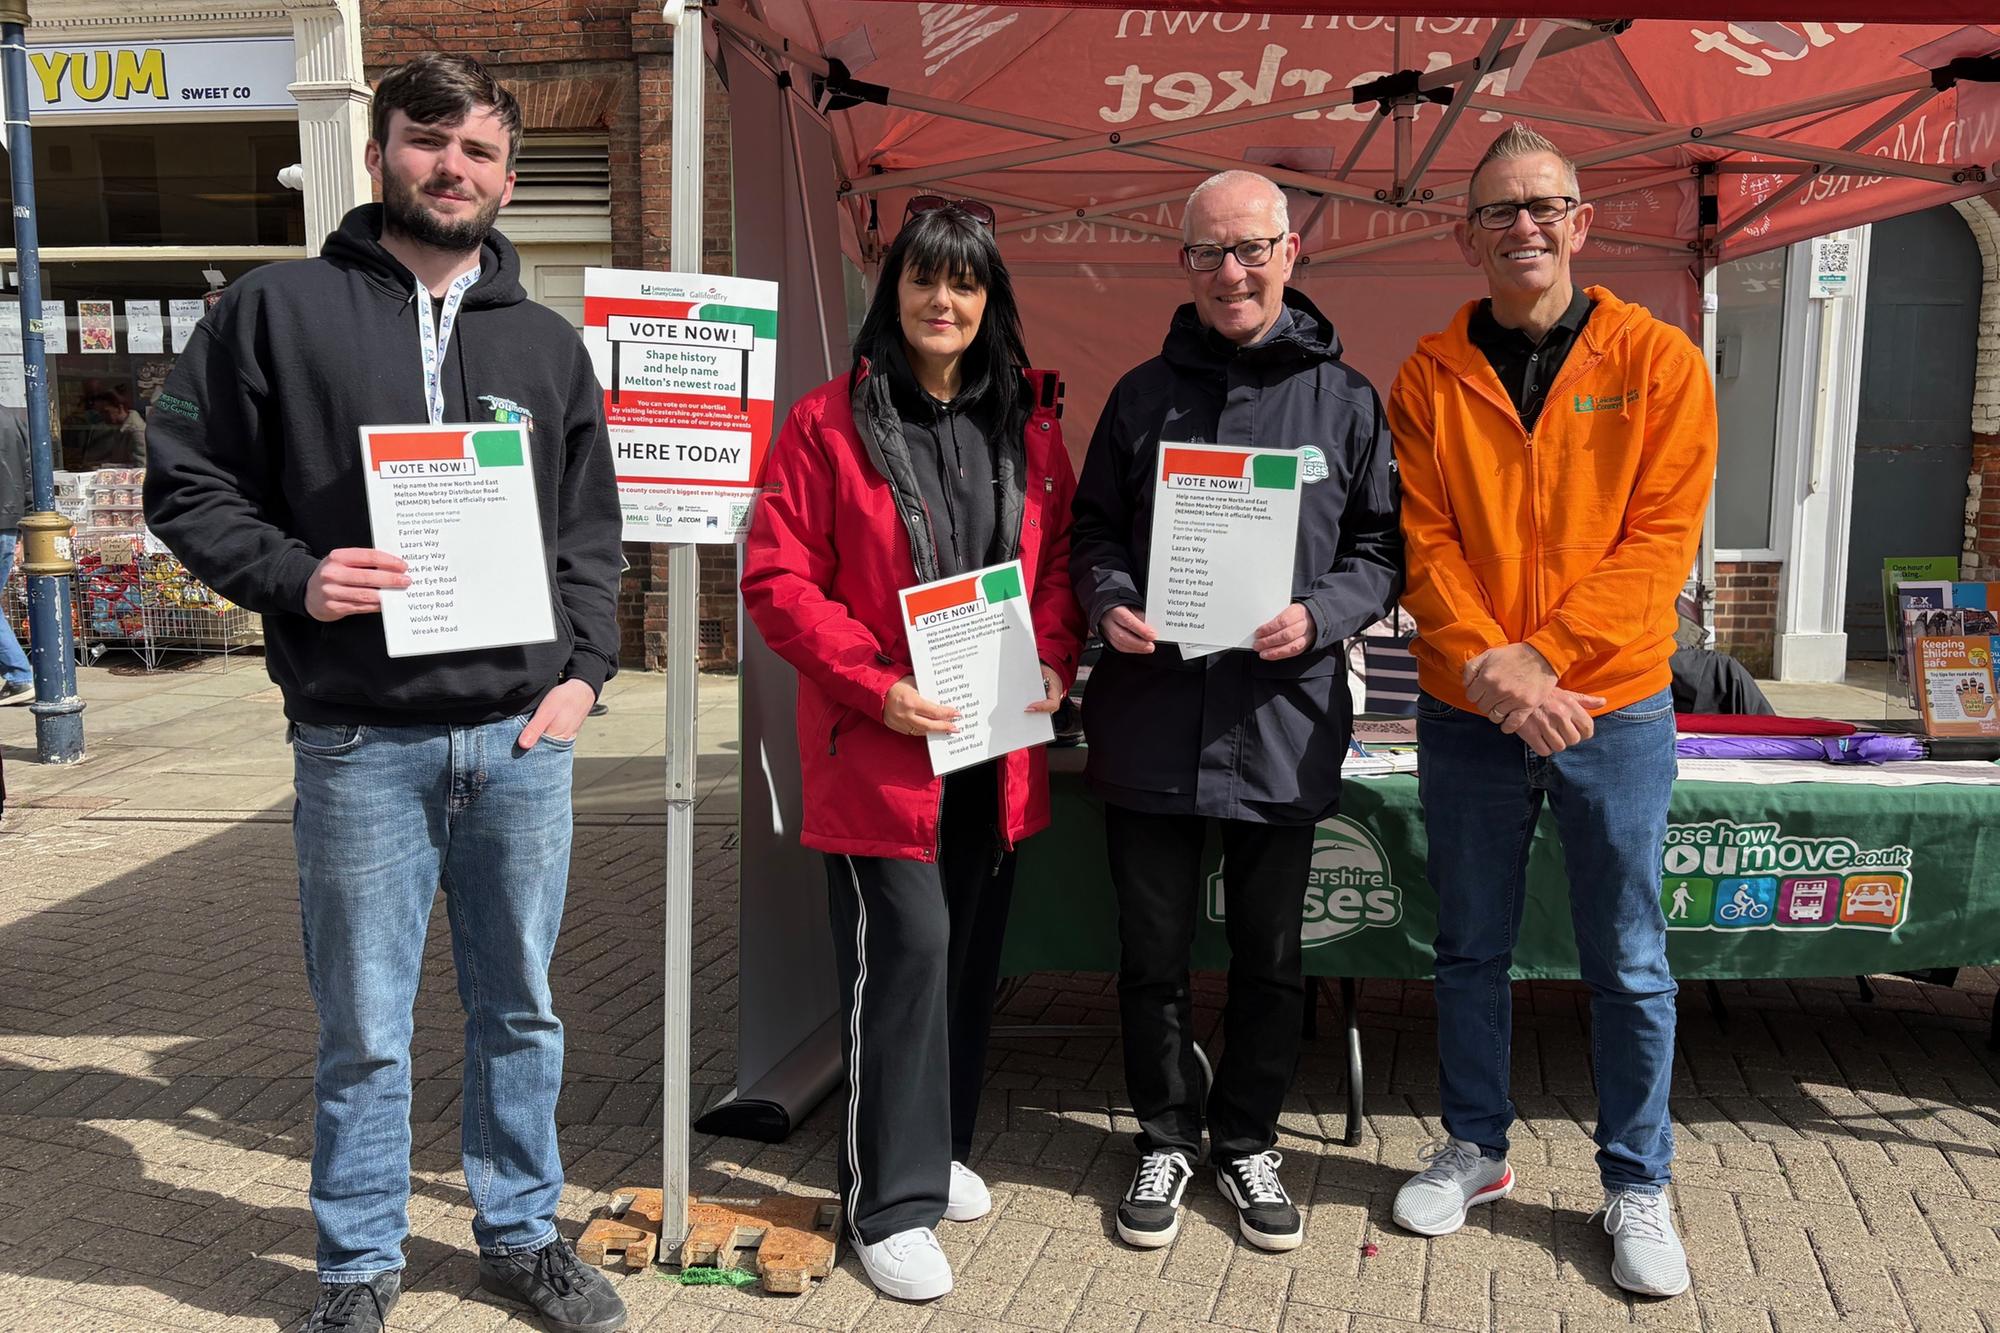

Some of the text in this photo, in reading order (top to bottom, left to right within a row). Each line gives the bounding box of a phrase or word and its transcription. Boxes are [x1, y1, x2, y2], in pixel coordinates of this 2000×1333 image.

[28, 48, 251, 104] YUM SWEET CO
[630, 322, 736, 343] VOTE NOW!
[646, 350, 717, 365] Shape history
[643, 364, 719, 376] and help name
[624, 376, 736, 391] Melton's newest road
[700, 402, 726, 411] shortlist
[621, 407, 645, 415] visiting
[646, 409, 733, 420] leicestershire.gov.uk/mmdr
[741, 413, 749, 422] by
[608, 415, 626, 423] using
[632, 416, 653, 424] voting
[710, 420, 722, 428] pop
[618, 442, 740, 463] HERE TODAY
[390, 462, 467, 474] VOTE NOW!
[393, 482, 408, 490] Help
[1177, 477, 1243, 490] VOTE NOW!
[394, 490, 417, 498] Melton
[418, 489, 447, 498] Mowbray
[449, 488, 482, 496] Distributor
[626, 487, 647, 495] county
[648, 487, 676, 495] council's
[677, 488, 699, 497] biggest
[714, 490, 739, 499] highways
[395, 498, 430, 507] (NEMMDR)
[431, 497, 452, 505] before
[459, 496, 486, 504] officially
[399, 528, 439, 536] Farrier Way
[424, 540, 439, 548] Way
[402, 552, 446, 561] Military Way
[1171, 555, 1194, 564] Military
[434, 564, 449, 572] Way
[1907, 563, 1924, 571] hour
[425, 577, 438, 586] Eye
[1185, 578, 1196, 586] Eye
[1197, 579, 1213, 587] Road
[406, 588, 454, 598] Veteran Road
[1168, 588, 1192, 596] Veteran
[408, 601, 454, 611] Victory Road
[1167, 599, 1206, 608] Victory Road
[409, 613, 448, 623] Wolds Way
[922, 602, 980, 625] VOTE NOW!
[1166, 609, 1199, 619] Wolds Way
[1165, 620, 1188, 628] Wreake
[412, 625, 458, 635] Wreake Road
[1922, 640, 1965, 650] Keeping
[1923, 649, 1966, 658] children
[952, 663, 963, 671] Way
[1923, 658, 1947, 667] safe
[953, 673, 964, 681] Way
[959, 682, 970, 690] Way
[961, 692, 973, 700] Way
[969, 740, 983, 749] Road
[1718, 827, 1772, 846] how
[1308, 869, 1384, 887] ershire
